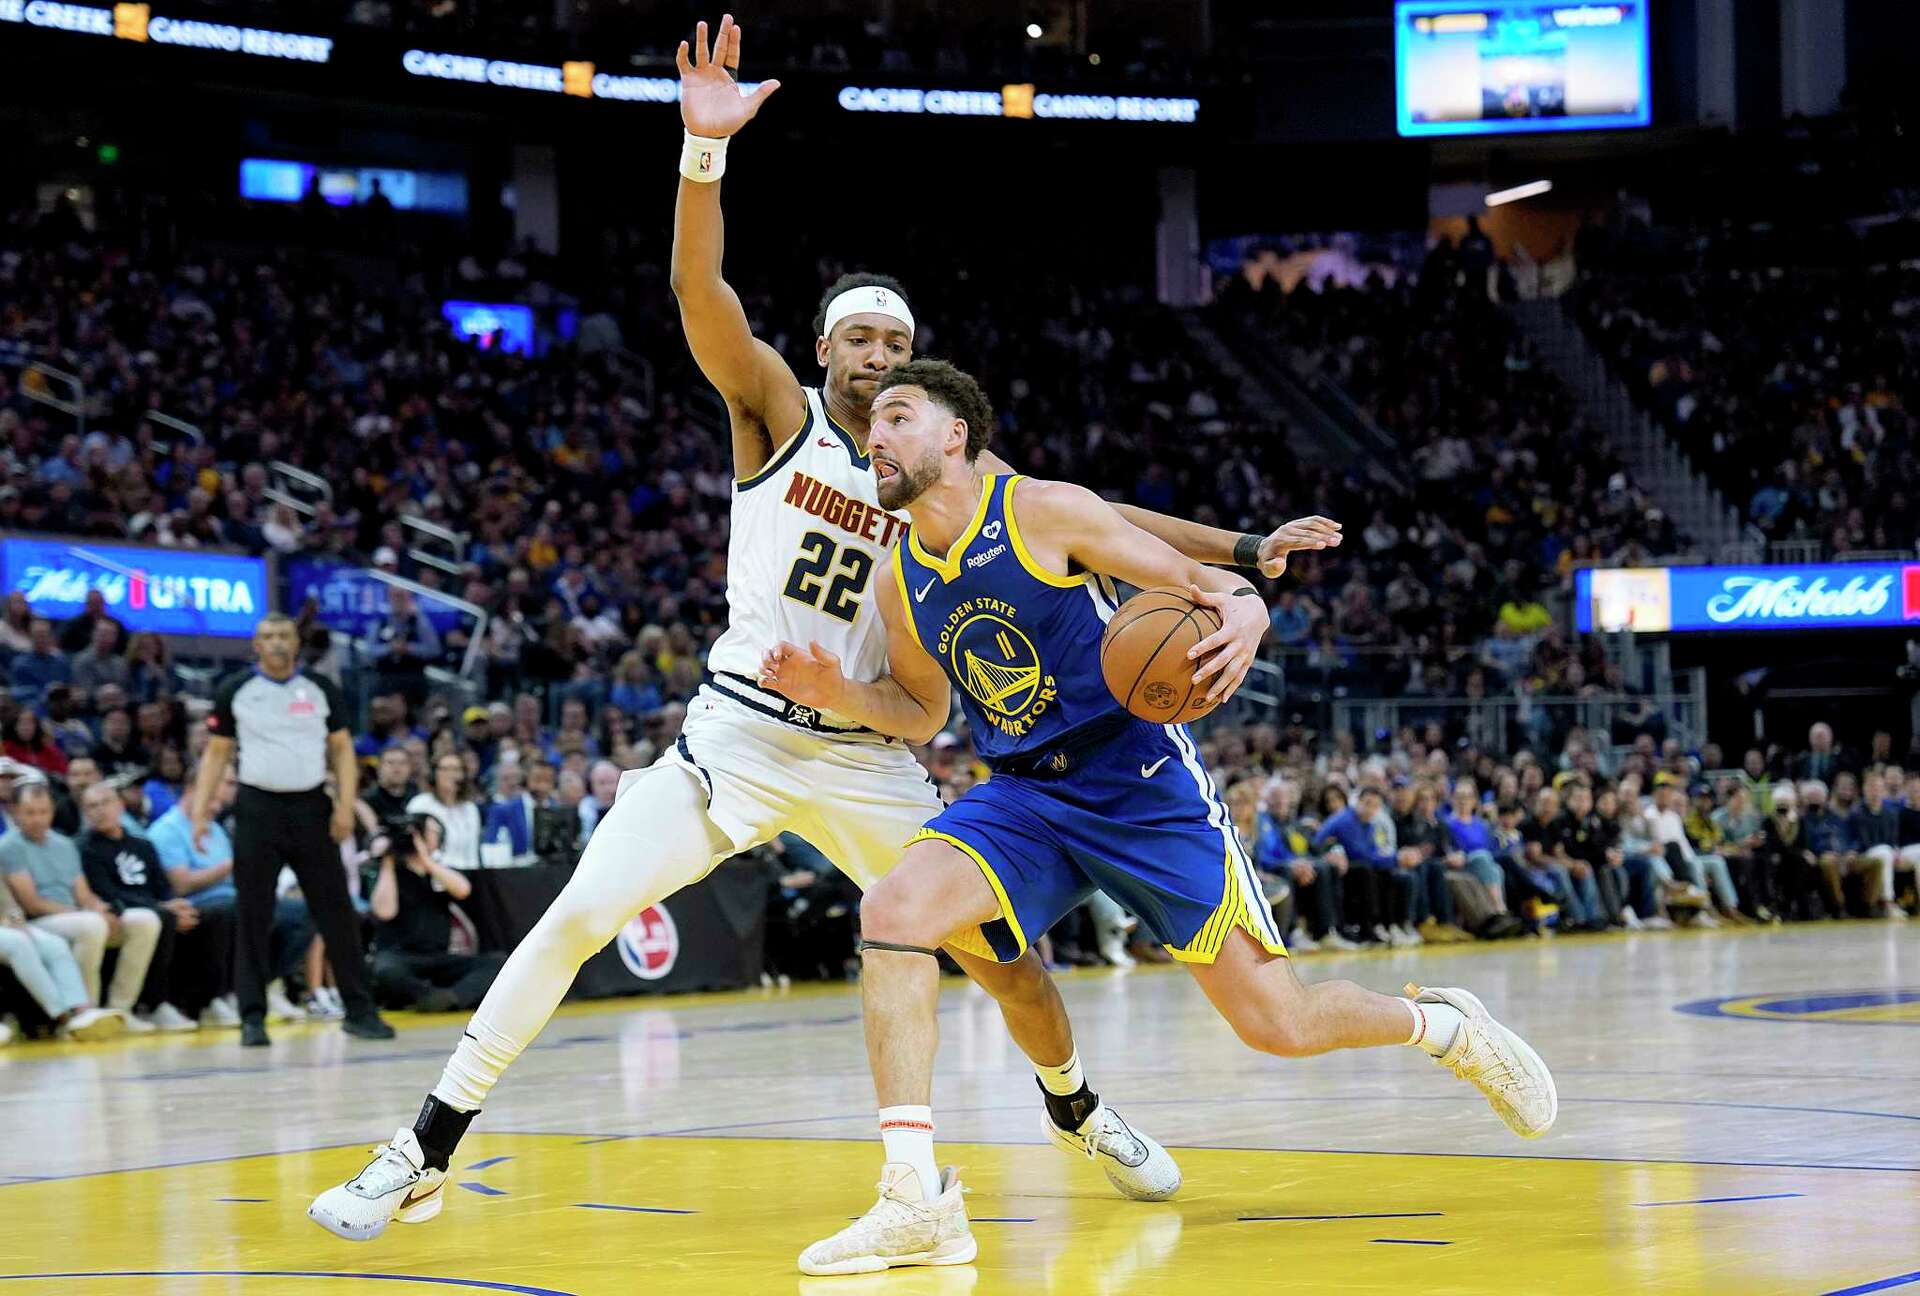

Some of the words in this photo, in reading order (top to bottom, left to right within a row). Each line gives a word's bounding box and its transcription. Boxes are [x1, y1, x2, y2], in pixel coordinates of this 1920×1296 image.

[25, 0, 112, 35] CREEK
[149, 17, 241, 50] CASINO
[242, 28, 332, 63] RESORT
[403, 50, 488, 82] CACHE
[487, 60, 563, 91] CREEK
[592, 74, 677, 102] CASINO
[838, 86, 924, 113] CACHE
[925, 89, 1003, 116] CREEK
[1033, 94, 1116, 119] CASINO
[1117, 97, 1199, 122] RESORT
[782, 530, 876, 624] 22
[966, 544, 1007, 568] Rakuten
[1706, 574, 1894, 623] Michelob
[938, 601, 974, 654] GOLDEN
[976, 597, 1017, 618] STATE
[995, 630, 1016, 660] 11
[982, 675, 1057, 737] WARRIORS
